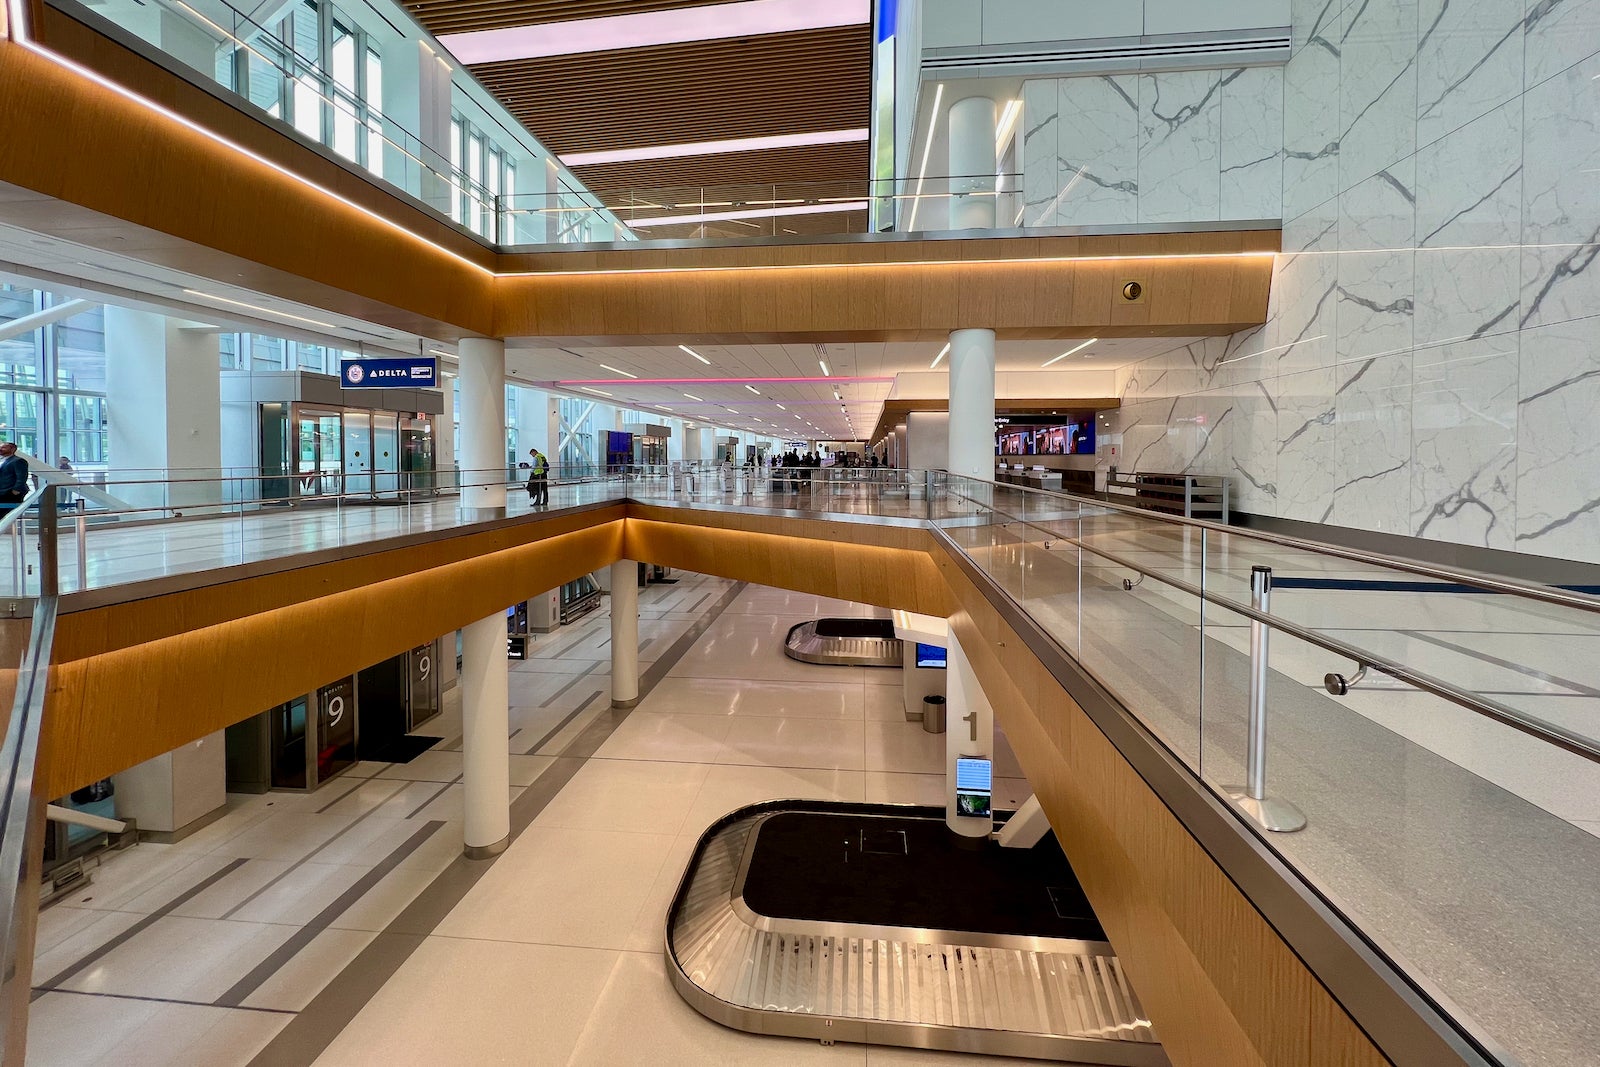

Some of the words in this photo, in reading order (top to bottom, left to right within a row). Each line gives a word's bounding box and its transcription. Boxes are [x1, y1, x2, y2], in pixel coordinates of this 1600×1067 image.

[420, 656, 430, 681] 9
[329, 696, 344, 727] 9
[963, 712, 976, 741] 1
